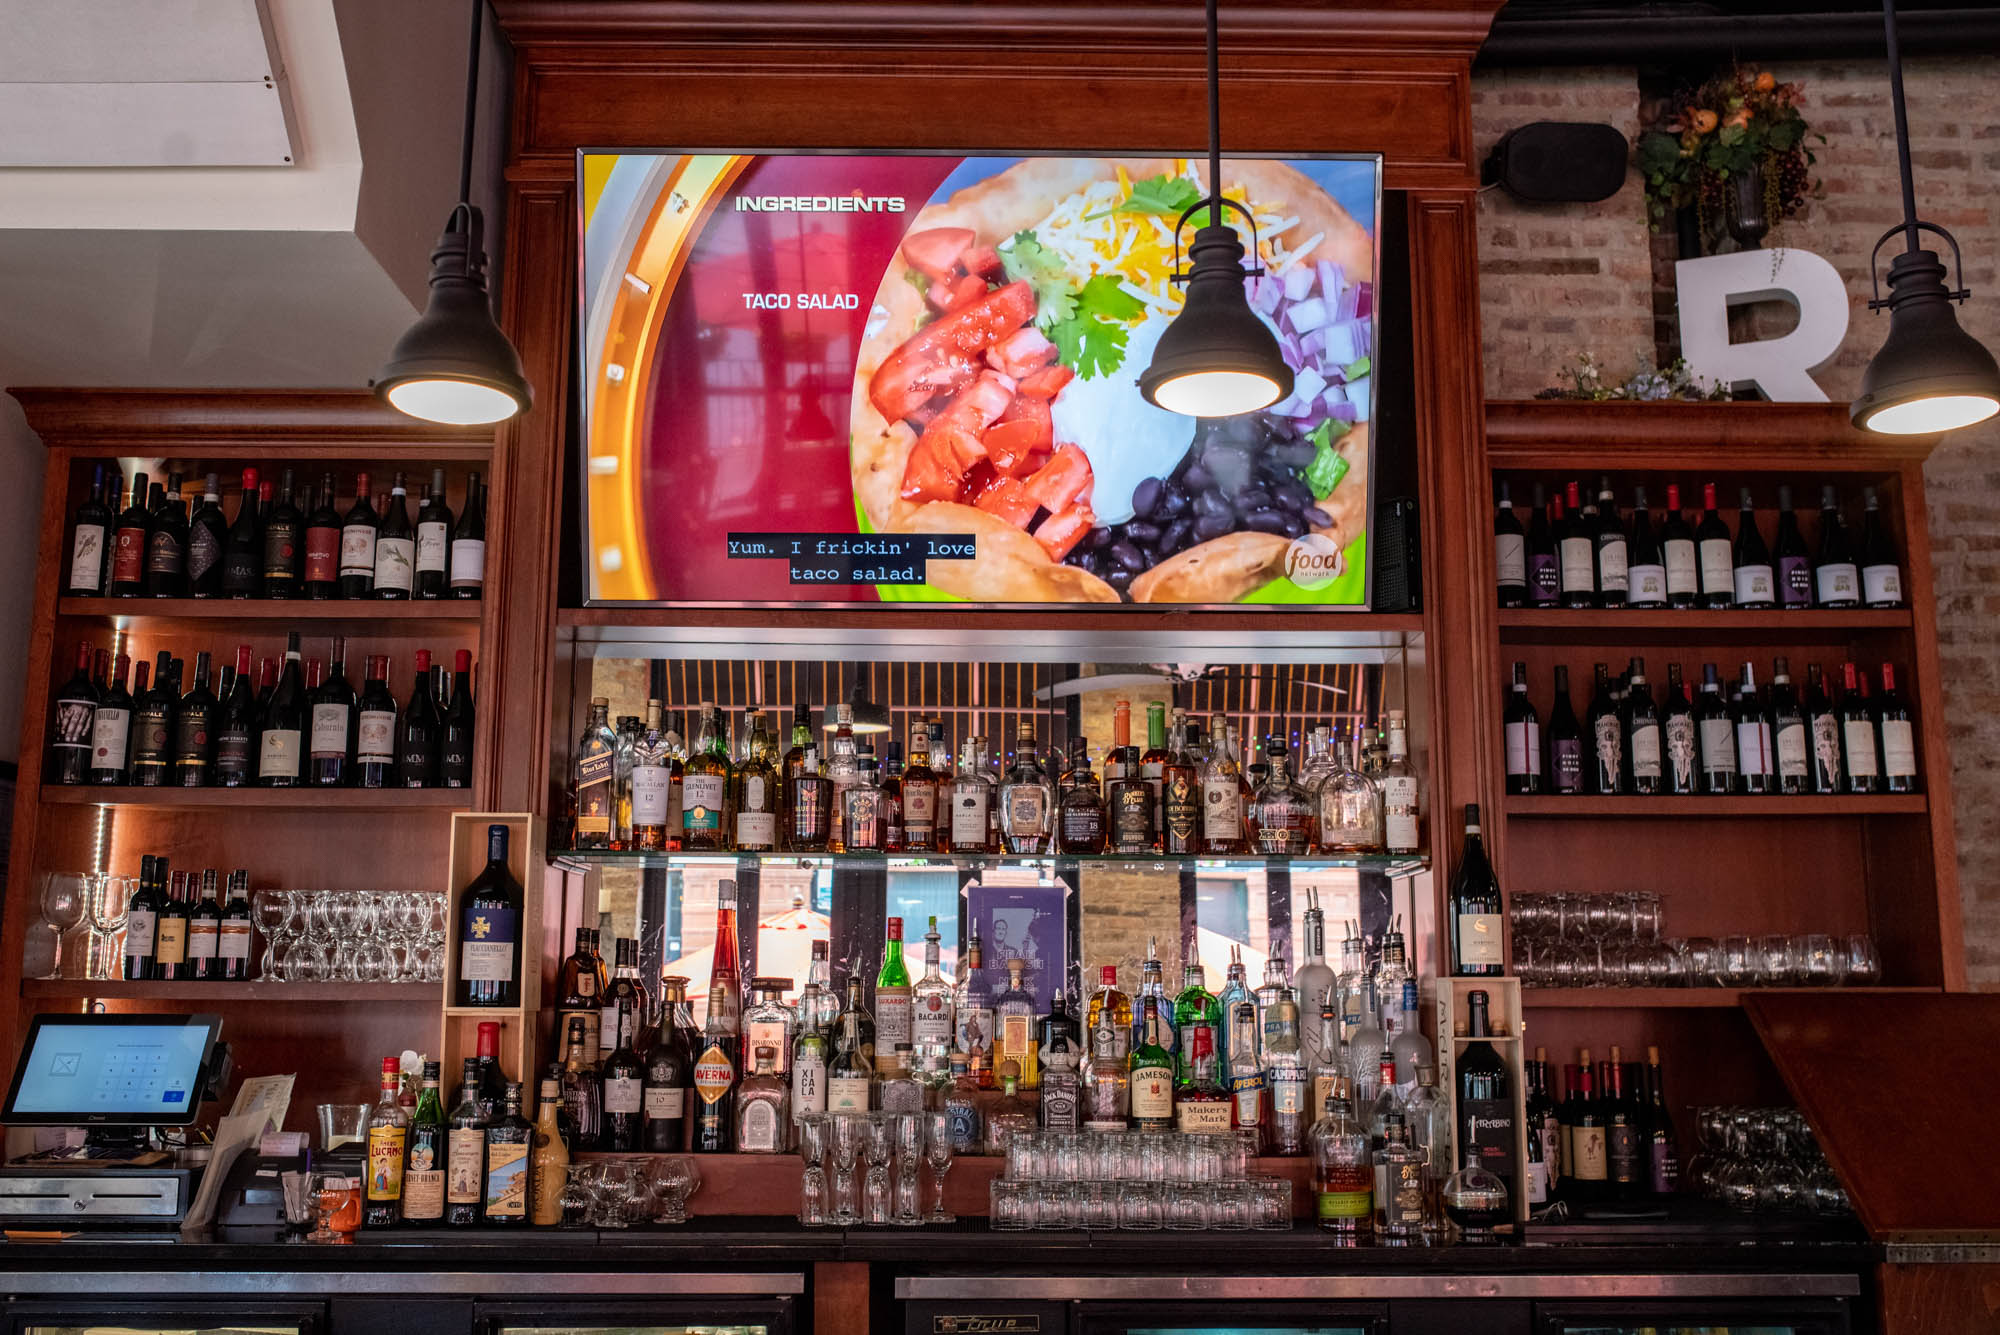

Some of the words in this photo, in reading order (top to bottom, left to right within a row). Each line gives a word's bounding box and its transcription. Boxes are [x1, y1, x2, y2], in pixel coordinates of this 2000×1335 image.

[735, 196, 906, 212] INGREDIENTS
[742, 293, 791, 309] TACO
[797, 293, 859, 309] SALAD
[1676, 247, 1850, 402] R
[729, 541, 775, 554] Yum.
[792, 541, 801, 554] I
[816, 540, 911, 555] frickin'
[927, 541, 976, 555] love
[1288, 546, 1340, 578] food
[791, 566, 840, 580] taco
[853, 566, 923, 581] salad.
[582, 764, 595, 774] Blue
[685, 783, 717, 792] GLENLIVET
[644, 793, 655, 801] 12
[695, 790, 705, 798] 12
[1088, 821, 1098, 830] 18
[695, 1070, 732, 1081] AVERNA
[1135, 1071, 1171, 1082] JAMESON
[1233, 1077, 1264, 1091] APEROL
[1043, 1092, 1057, 1105] JACK
[1187, 1106, 1228, 1115] Maker's
[1199, 1115, 1227, 1123] Mark
[371, 1144, 403, 1158] LUCANO
